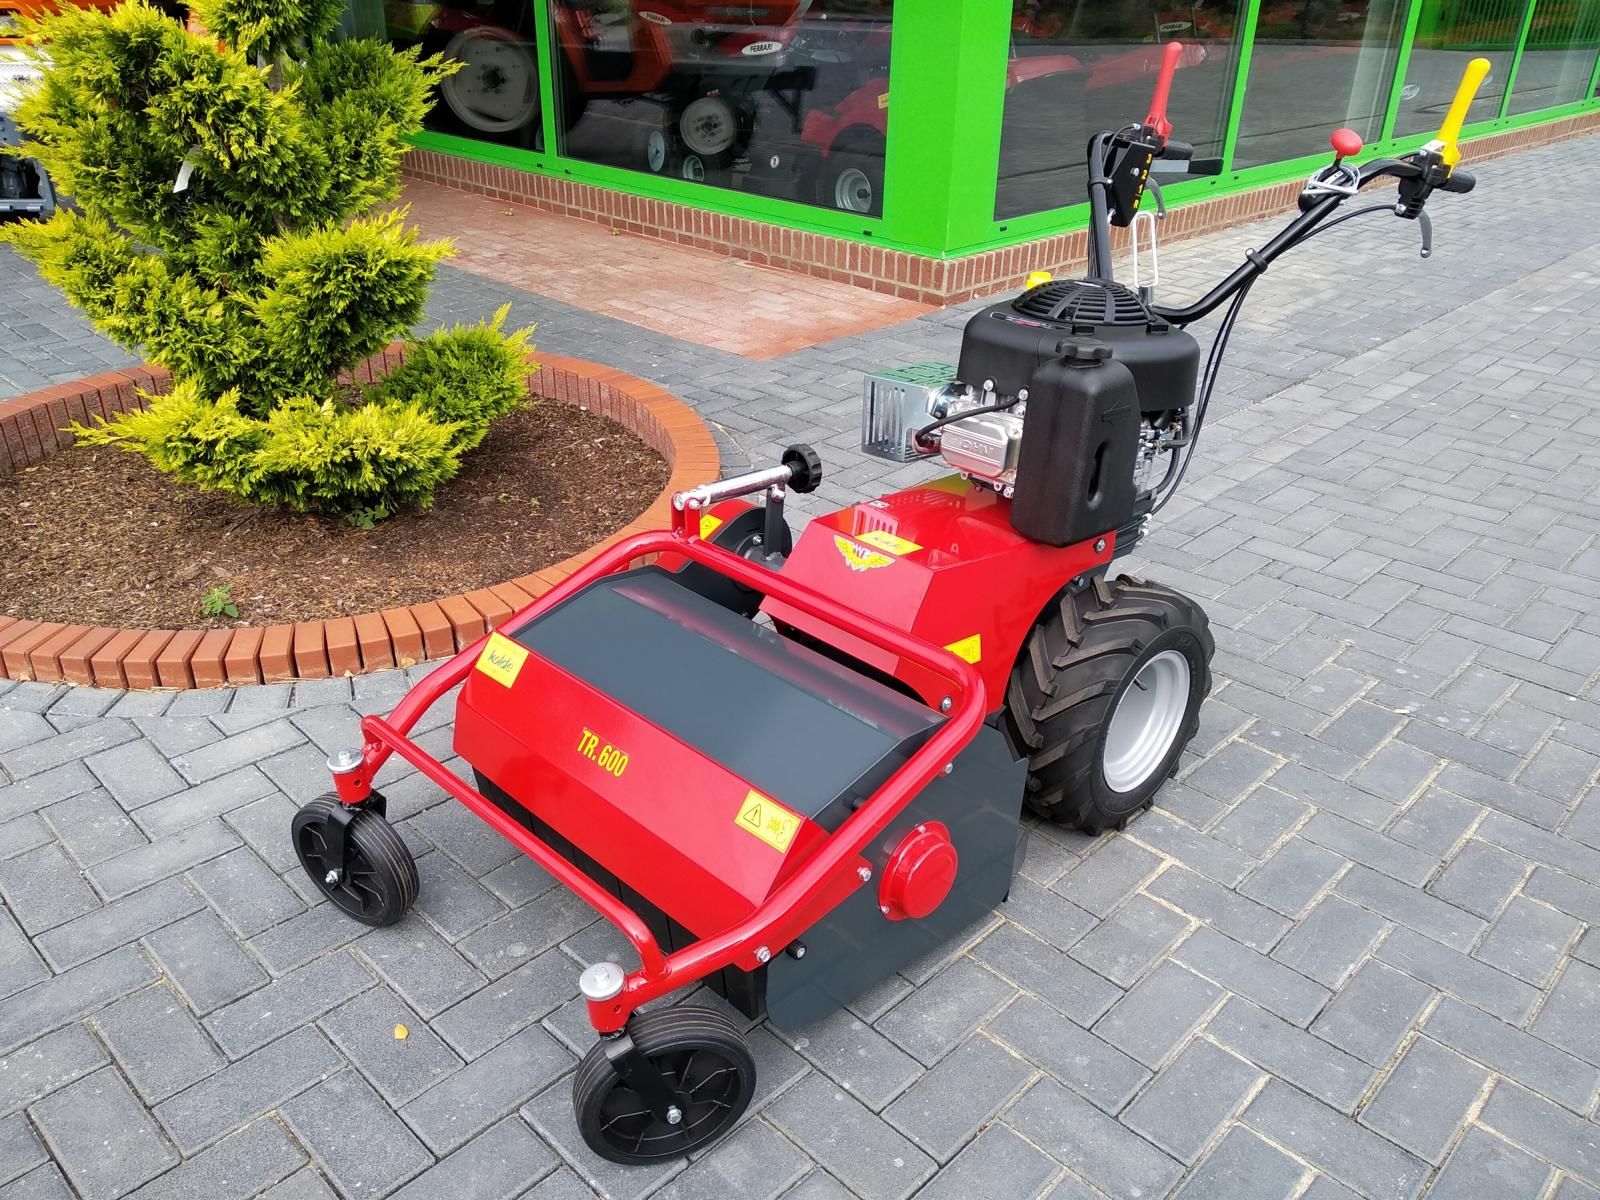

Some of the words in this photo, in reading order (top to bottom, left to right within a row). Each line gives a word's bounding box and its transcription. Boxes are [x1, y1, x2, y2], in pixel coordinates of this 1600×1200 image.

[750, 43, 773, 52] FERRARI
[1146, 153, 1153, 165] 3
[1141, 169, 1148, 180] 2
[1138, 183, 1144, 194] 1
